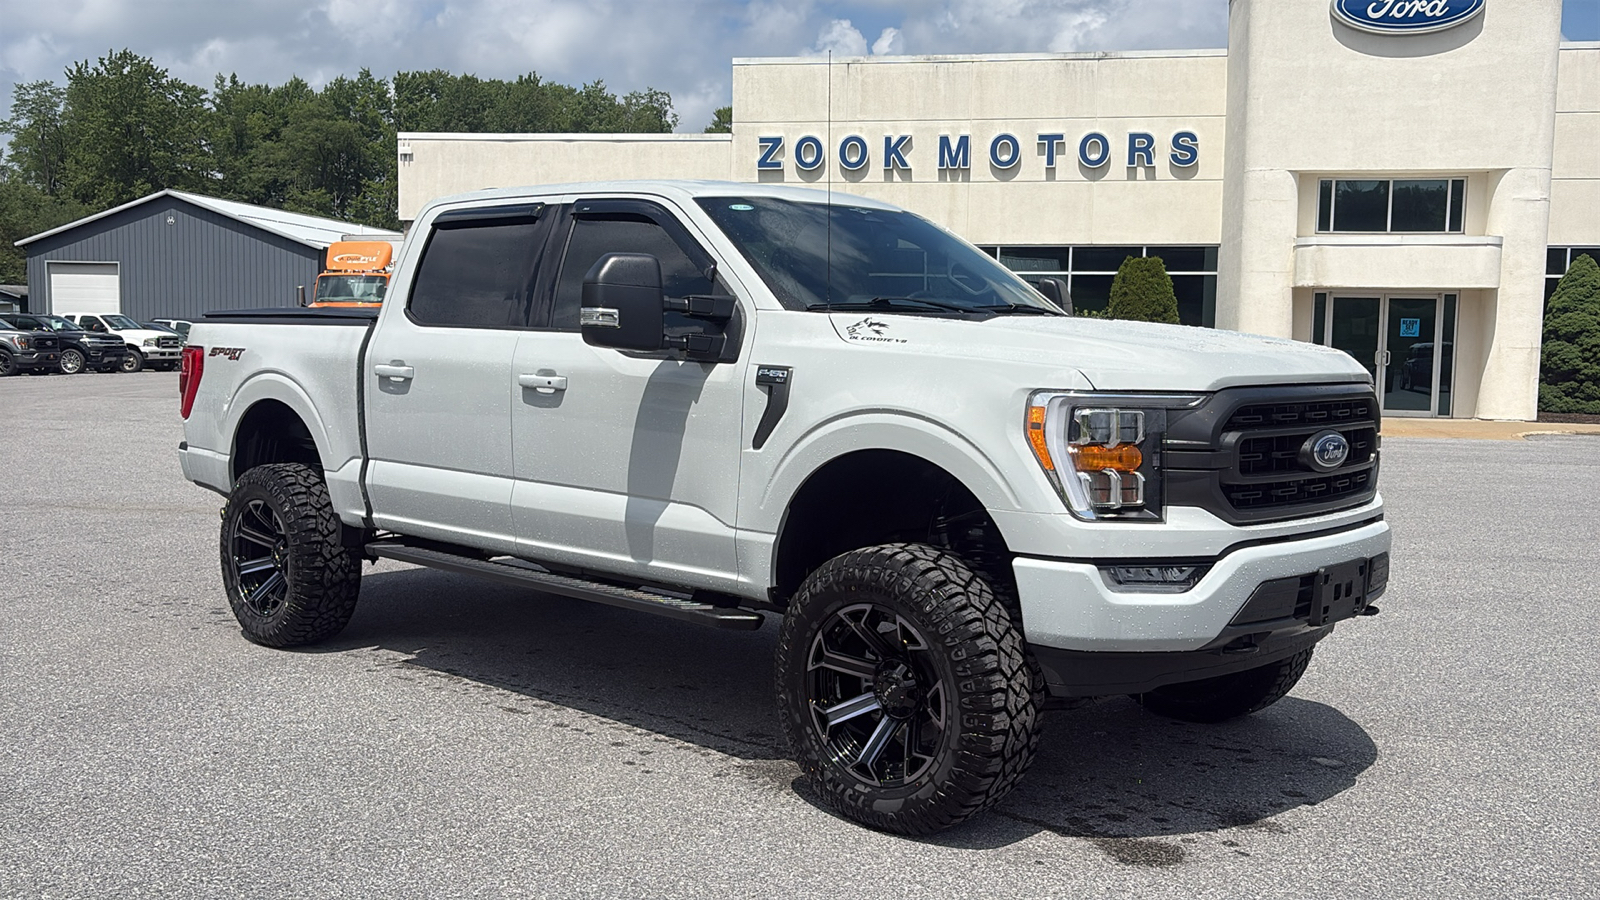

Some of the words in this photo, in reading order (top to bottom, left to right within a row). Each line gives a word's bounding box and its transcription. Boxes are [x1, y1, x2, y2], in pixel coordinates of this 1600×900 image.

[757, 136, 912, 170] ZOOK
[938, 131, 1198, 170] MOTORS
[208, 346, 246, 359] SPORT
[758, 368, 788, 378] F-150
[1324, 441, 1343, 459] Ford
